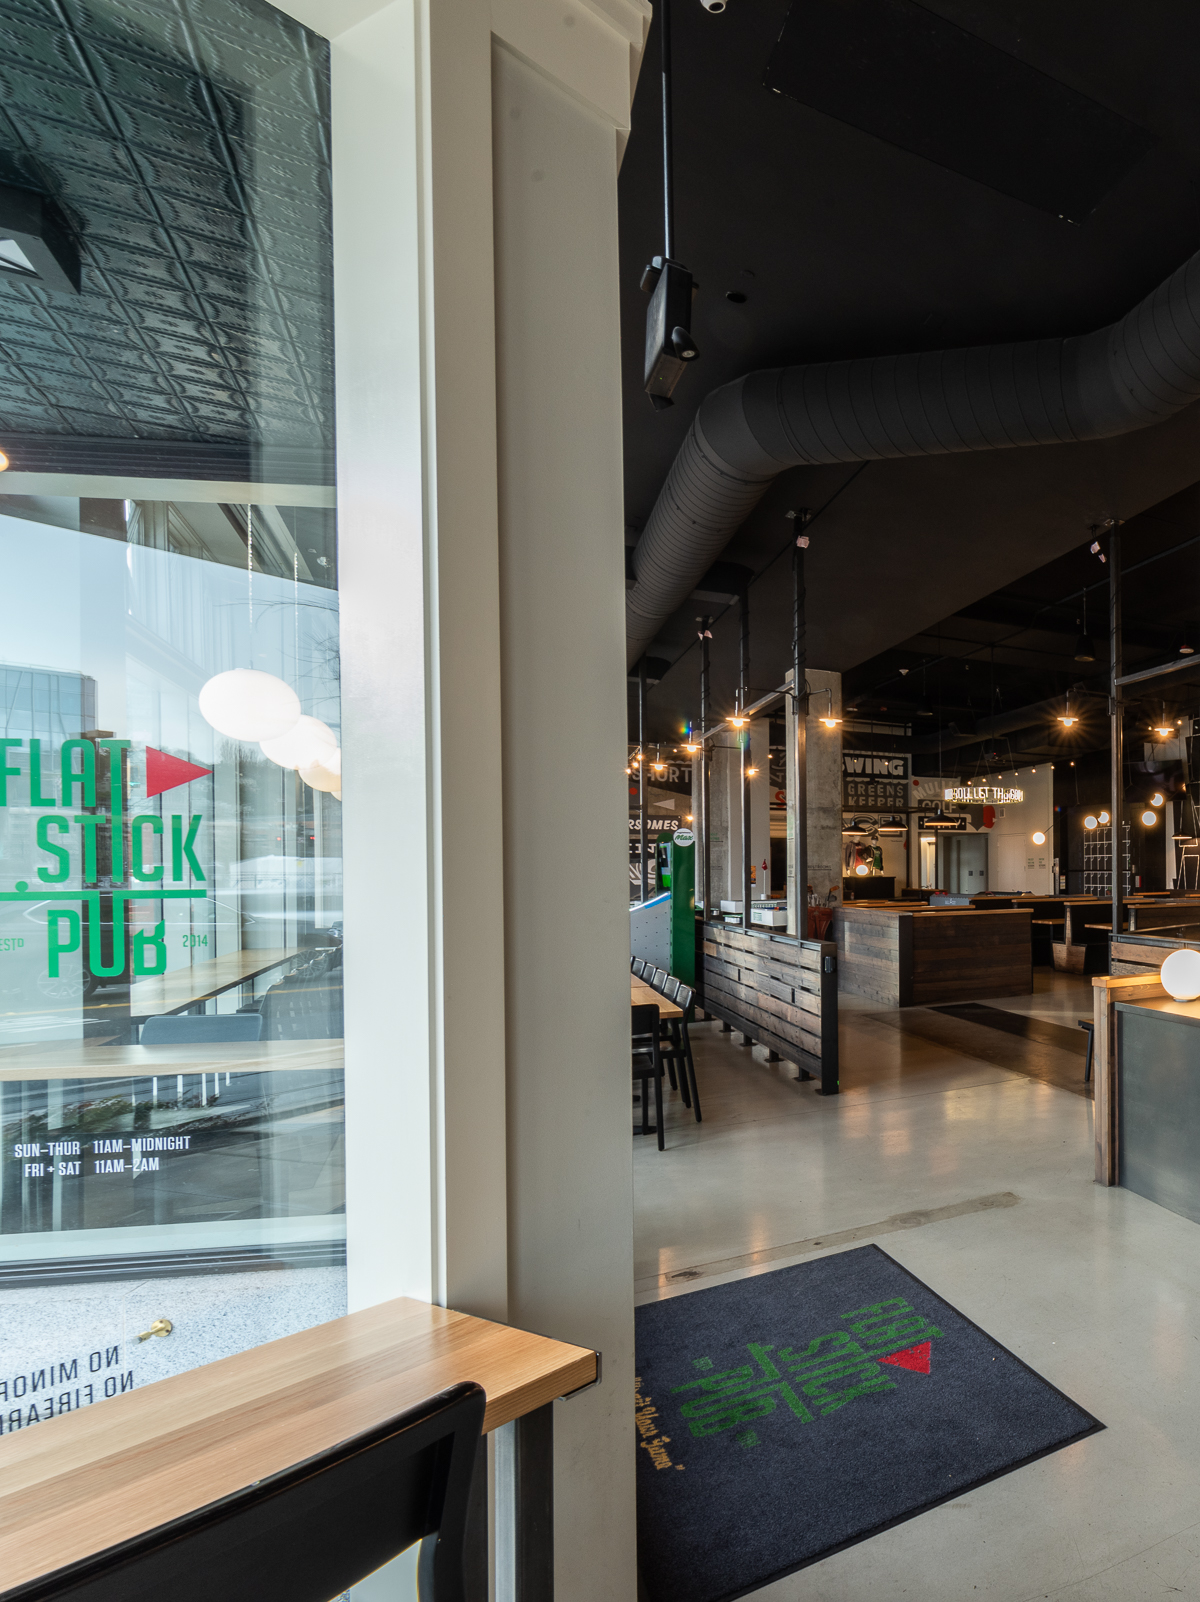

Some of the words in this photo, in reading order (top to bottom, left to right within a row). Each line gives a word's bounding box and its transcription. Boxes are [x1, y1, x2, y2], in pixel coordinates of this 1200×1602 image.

[0, 738, 131, 807] FLAT
[842, 757, 905, 776] WING
[847, 783, 904, 796] GREENS
[921, 800, 957, 813] GOLF
[37, 814, 206, 883] STICK
[47, 908, 167, 978] PUB
[182, 934, 208, 947] 2014
[14, 1141, 81, 1158] SUN-THUR
[93, 1136, 191, 1154] 11AM-MIDNIGHT
[24, 1163, 44, 1178] FRI
[58, 1161, 81, 1176] SAT
[94, 1157, 160, 1174] 11AM-2AM
[840, 1297, 944, 1350] FLAT
[777, 1331, 897, 1416] STICK
[670, 1364, 777, 1438] PUB
